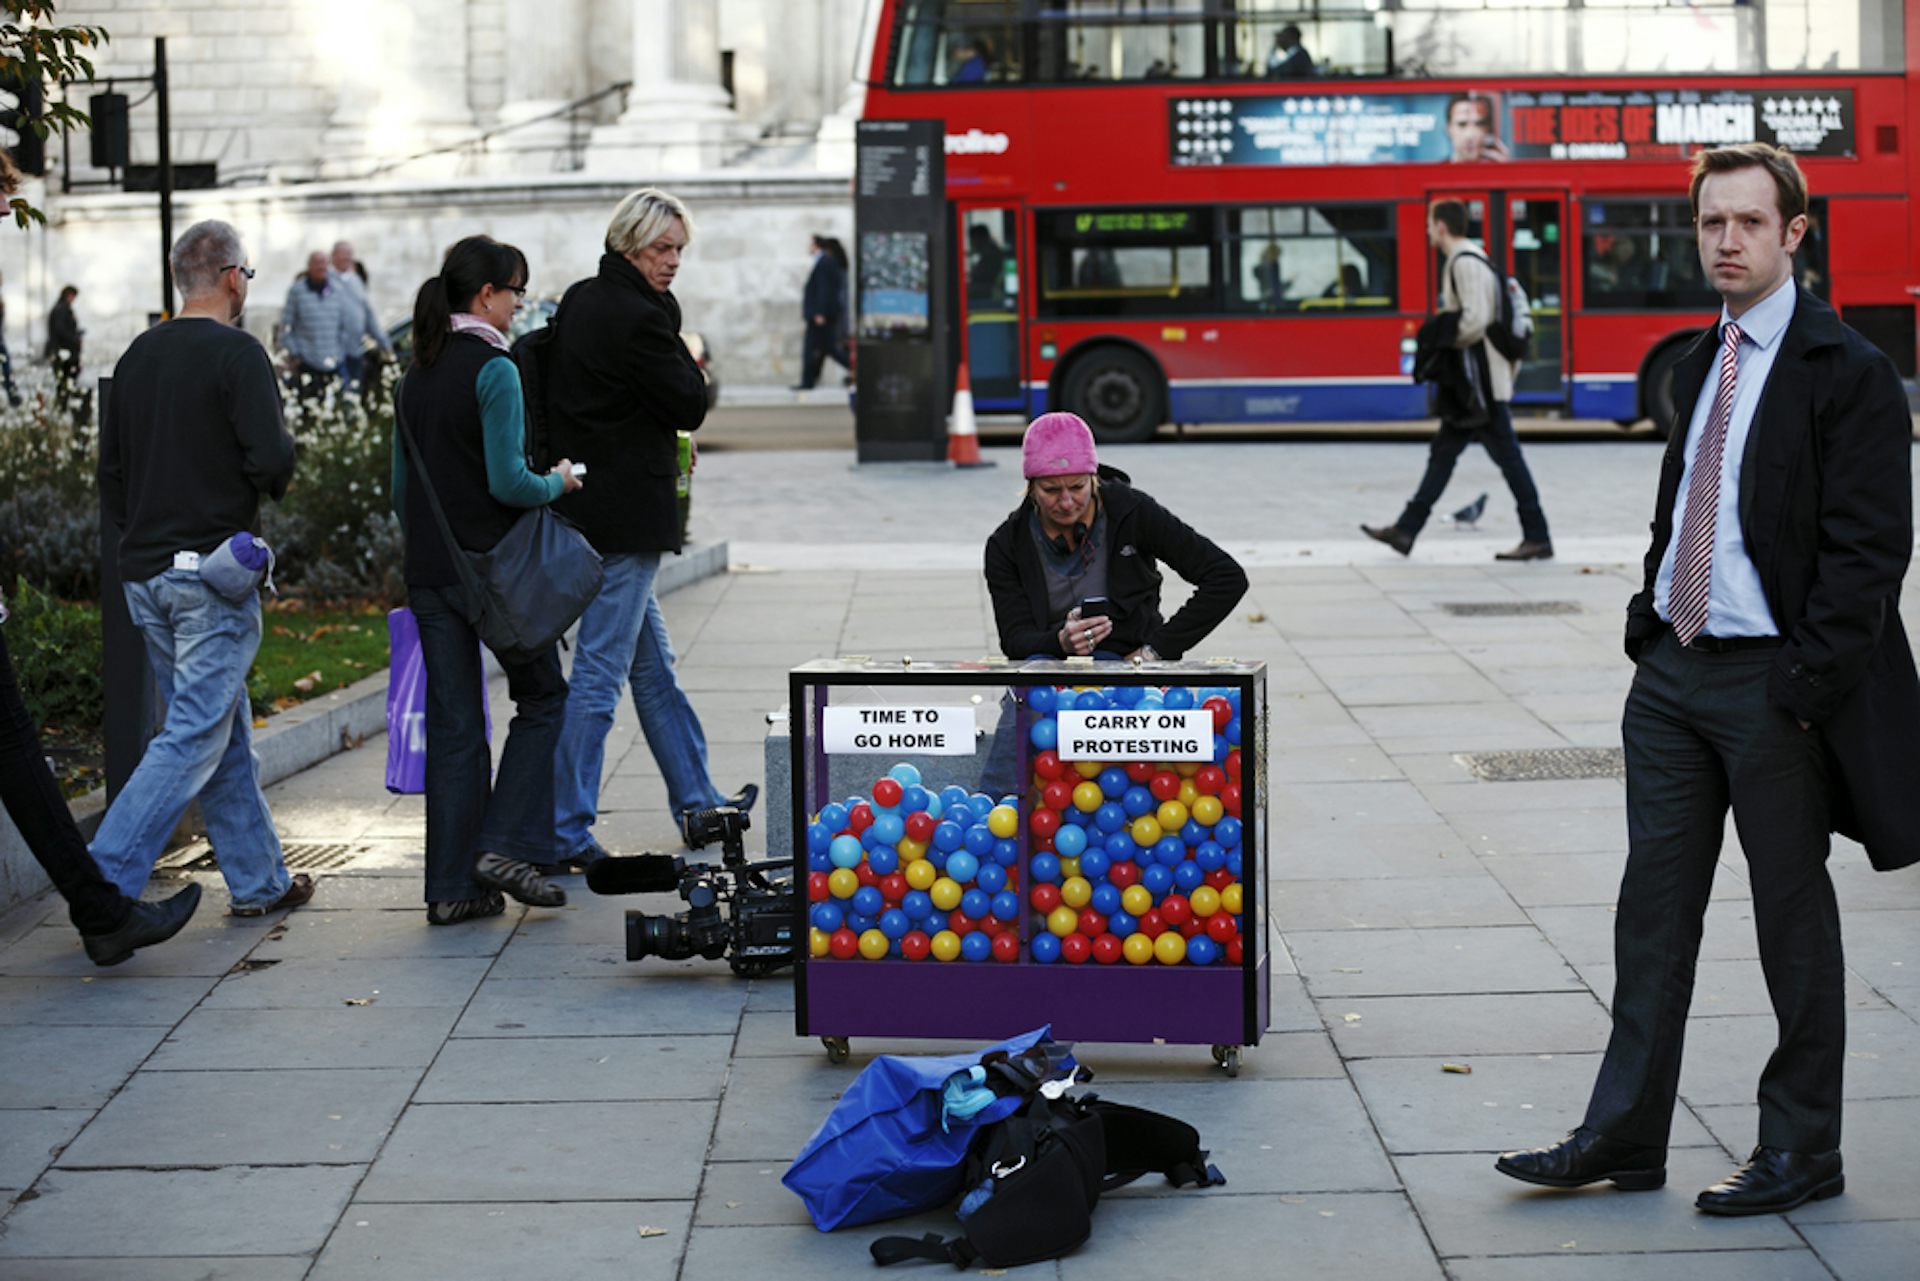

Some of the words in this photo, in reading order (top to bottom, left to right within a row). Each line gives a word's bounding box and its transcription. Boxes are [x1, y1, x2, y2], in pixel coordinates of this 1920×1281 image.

[1511, 106, 1555, 144] THE
[1561, 105, 1618, 143] IDES
[1622, 104, 1654, 142] OF
[1656, 103, 1754, 143] MARCH
[860, 710, 907, 723] TIME
[913, 709, 939, 723] TO
[1084, 715, 1150, 729] CARRY
[1158, 715, 1185, 729] ON
[854, 734, 882, 748] GO
[889, 734, 945, 748] HOME
[1073, 740, 1198, 754] PROTESTING
